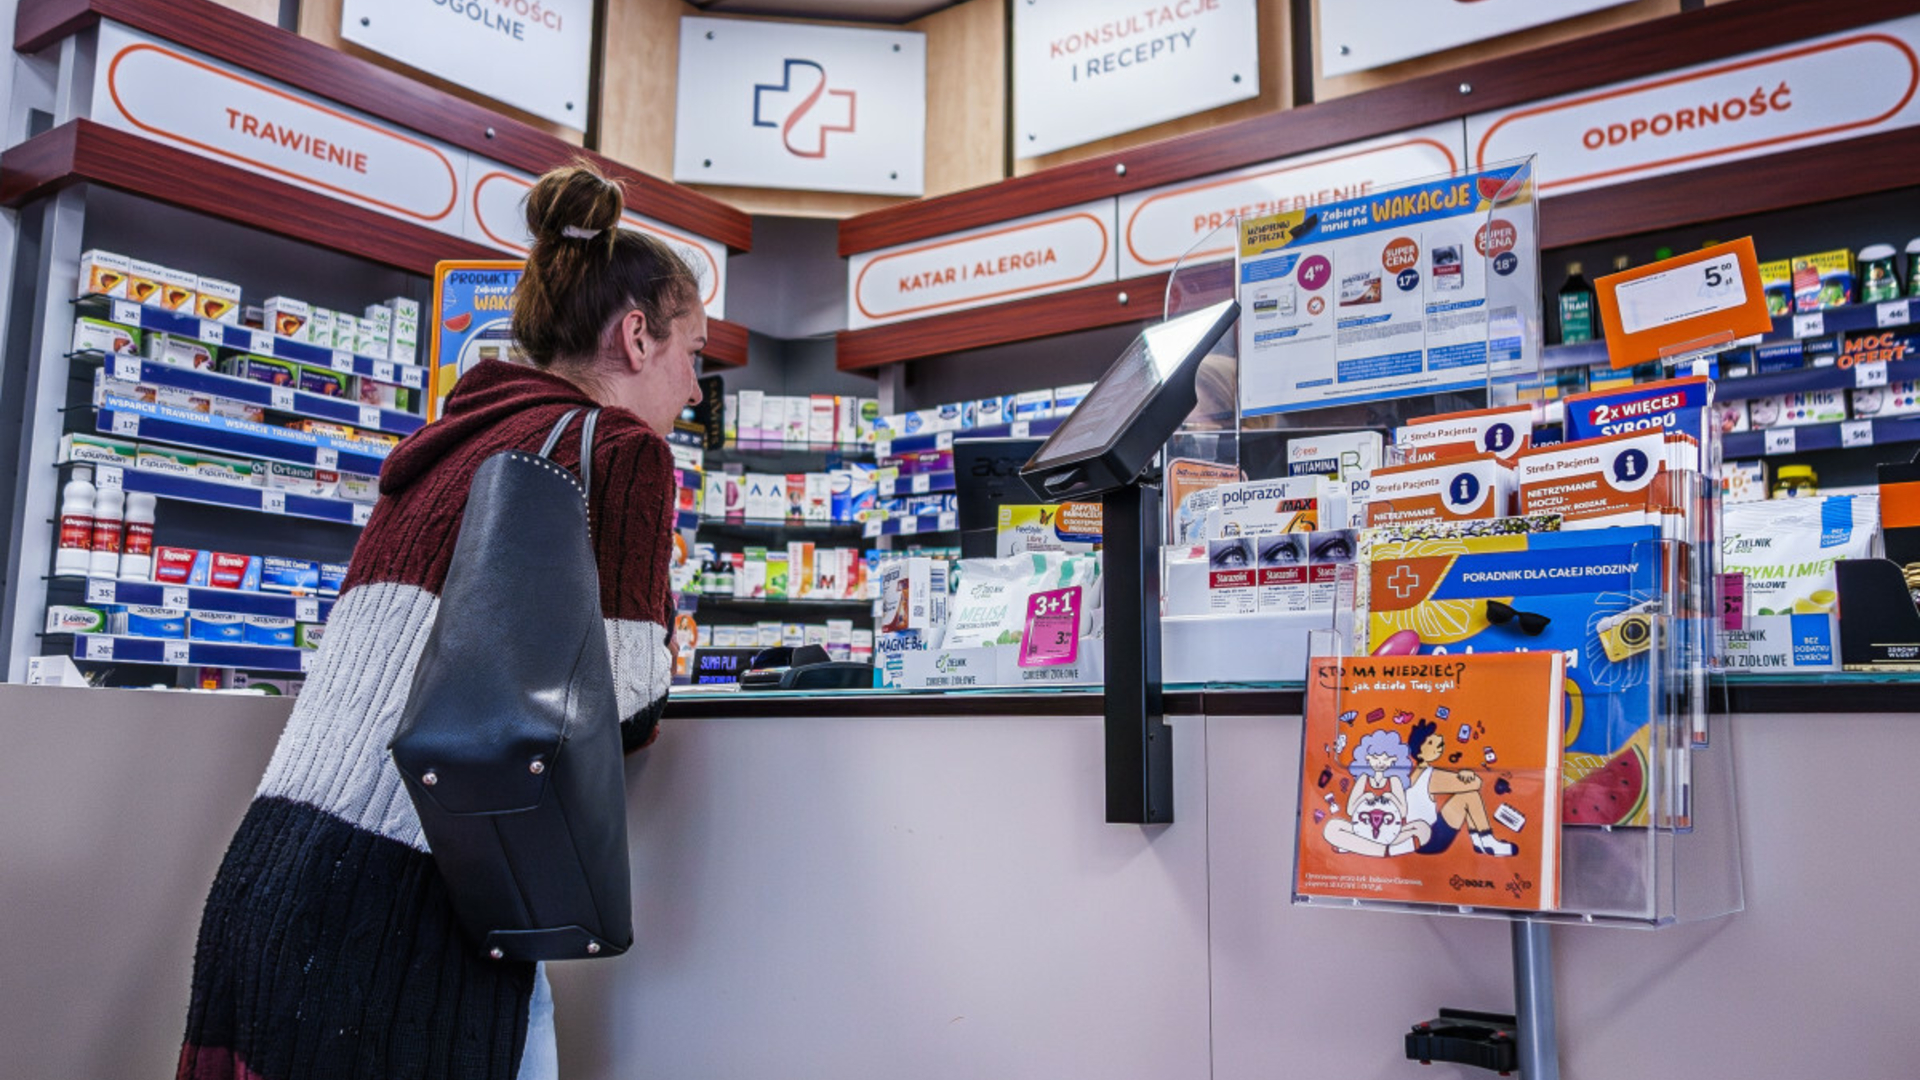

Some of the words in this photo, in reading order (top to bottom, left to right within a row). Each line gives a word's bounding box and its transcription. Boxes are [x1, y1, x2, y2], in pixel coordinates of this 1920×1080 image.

[1072, 64, 1078, 82] I
[1086, 28, 1197, 78] RECEPTY
[1583, 82, 1793, 150] ODPORNOŚĆ
[226, 107, 368, 174] TRAWIENIE
[1321, 205, 1367, 222] Zabierz
[1372, 183, 1470, 223] WAKACJE
[1321, 222, 1350, 233] mnie
[1352, 217, 1368, 227] na
[1479, 227, 1512, 241] SUPER
[1386, 245, 1415, 258] SUPER
[1479, 236, 1513, 251] CENA
[1386, 255, 1415, 268] CENA
[899, 269, 956, 293] KATAR
[962, 265, 967, 281] I
[972, 247, 1057, 280] ALERGIA
[1705, 265, 1722, 287] 5
[450, 272, 508, 285] PRODUKT
[1845, 333, 1894, 353] MOC
[1838, 345, 1907, 370] OFERT
[1594, 404, 1619, 426] 2x
[1621, 394, 1680, 416] WIĘCEJ
[108, 397, 157, 414] WSPARCIE
[160, 406, 211, 424] TRAWIENIA
[225, 419, 268, 435] WSPARCIE
[272, 428, 317, 443] TRAWIENIA
[1410, 433, 1436, 442] Strefa
[1437, 426, 1478, 438] Pacjenta
[74, 448, 127, 465] Espumisan
[140, 458, 189, 473] Espumisan
[273, 463, 314, 478] Ortanol
[1292, 460, 1337, 474] WITAMINA
[1526, 463, 1555, 475] Strefa
[1556, 456, 1600, 471] Pacjenta
[199, 467, 244, 482] Espumisan
[1375, 484, 1402, 494] Strefa
[1402, 478, 1440, 490] Pacjenta
[1527, 480, 1598, 499] NIETRZYMANIE
[1222, 484, 1287, 507] polprazol
[1527, 496, 1565, 509] MOCZU
[1282, 500, 1312, 512] MAX
[1735, 538, 1772, 549] ZIELNIK
[1463, 570, 1522, 582] PORADNIK
[1524, 568, 1547, 579] DLA
[1549, 566, 1583, 578] CAŁEJ
[1586, 563, 1639, 576] RODZINY
[1788, 564, 1795, 578] I
[960, 604, 1009, 621] MELISA
[306, 630, 323, 640] XEN
[1803, 637, 1819, 645] BEZ
[1739, 654, 1788, 667] ZIOŁOWE
[1318, 666, 1346, 679] KTO
[1353, 665, 1376, 678] MA
[1351, 682, 1370, 694] jak
[1410, 679, 1433, 693] Twój
[1435, 680, 1454, 693] cykl
